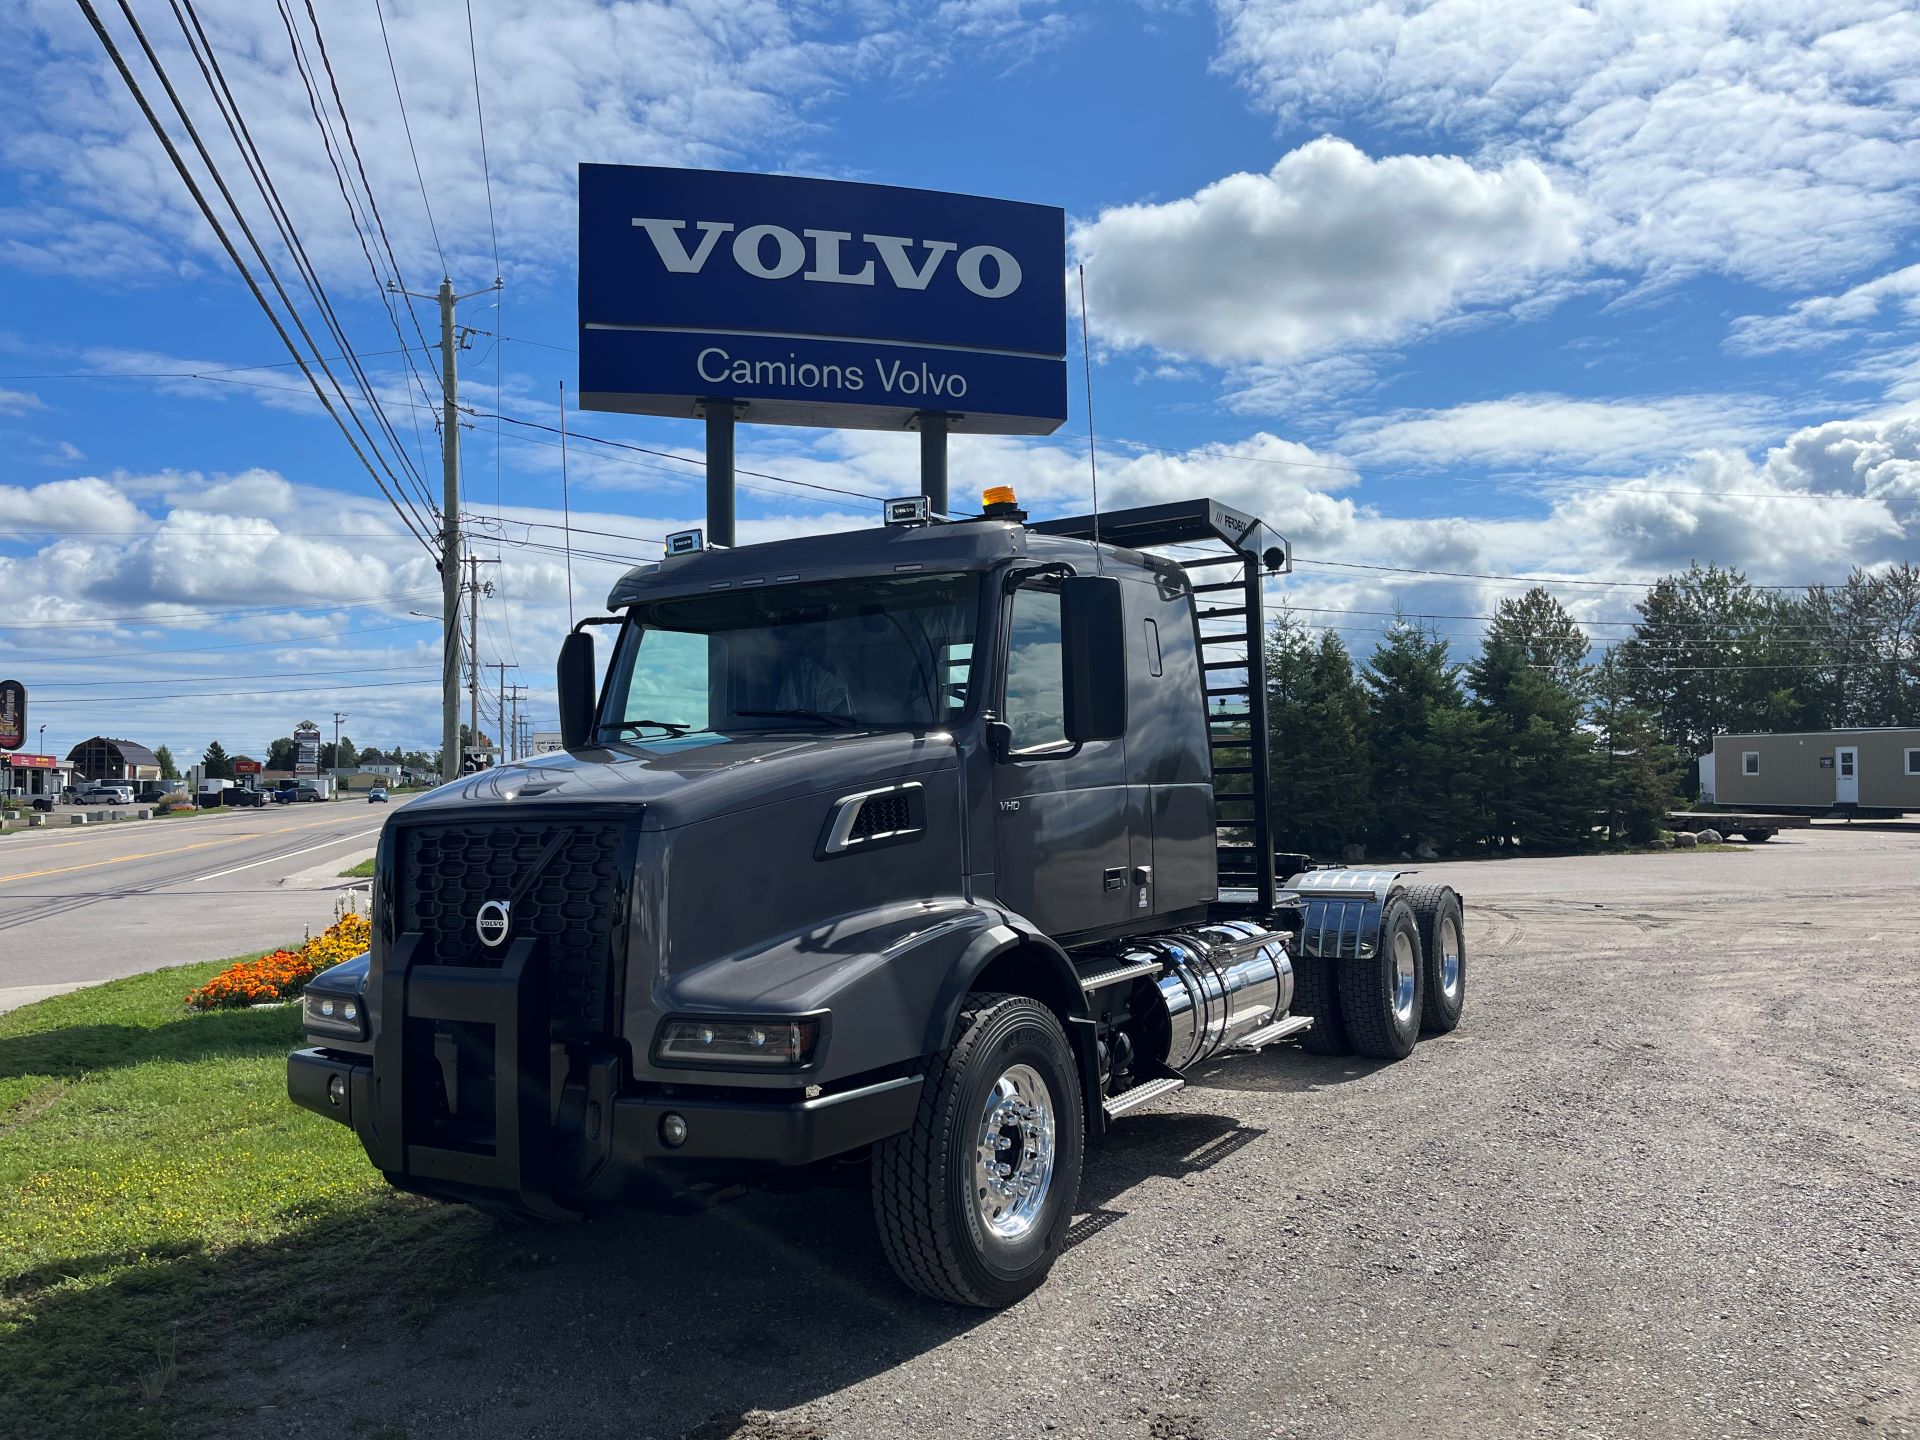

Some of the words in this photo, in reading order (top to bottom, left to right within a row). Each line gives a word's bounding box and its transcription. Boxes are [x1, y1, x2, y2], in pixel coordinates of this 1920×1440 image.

[631, 217, 1023, 298] VOLVO
[696, 348, 864, 390] Camions
[875, 358, 968, 398] Volvo
[674, 539, 692, 547] VOLVO
[999, 801, 1020, 810] VHD
